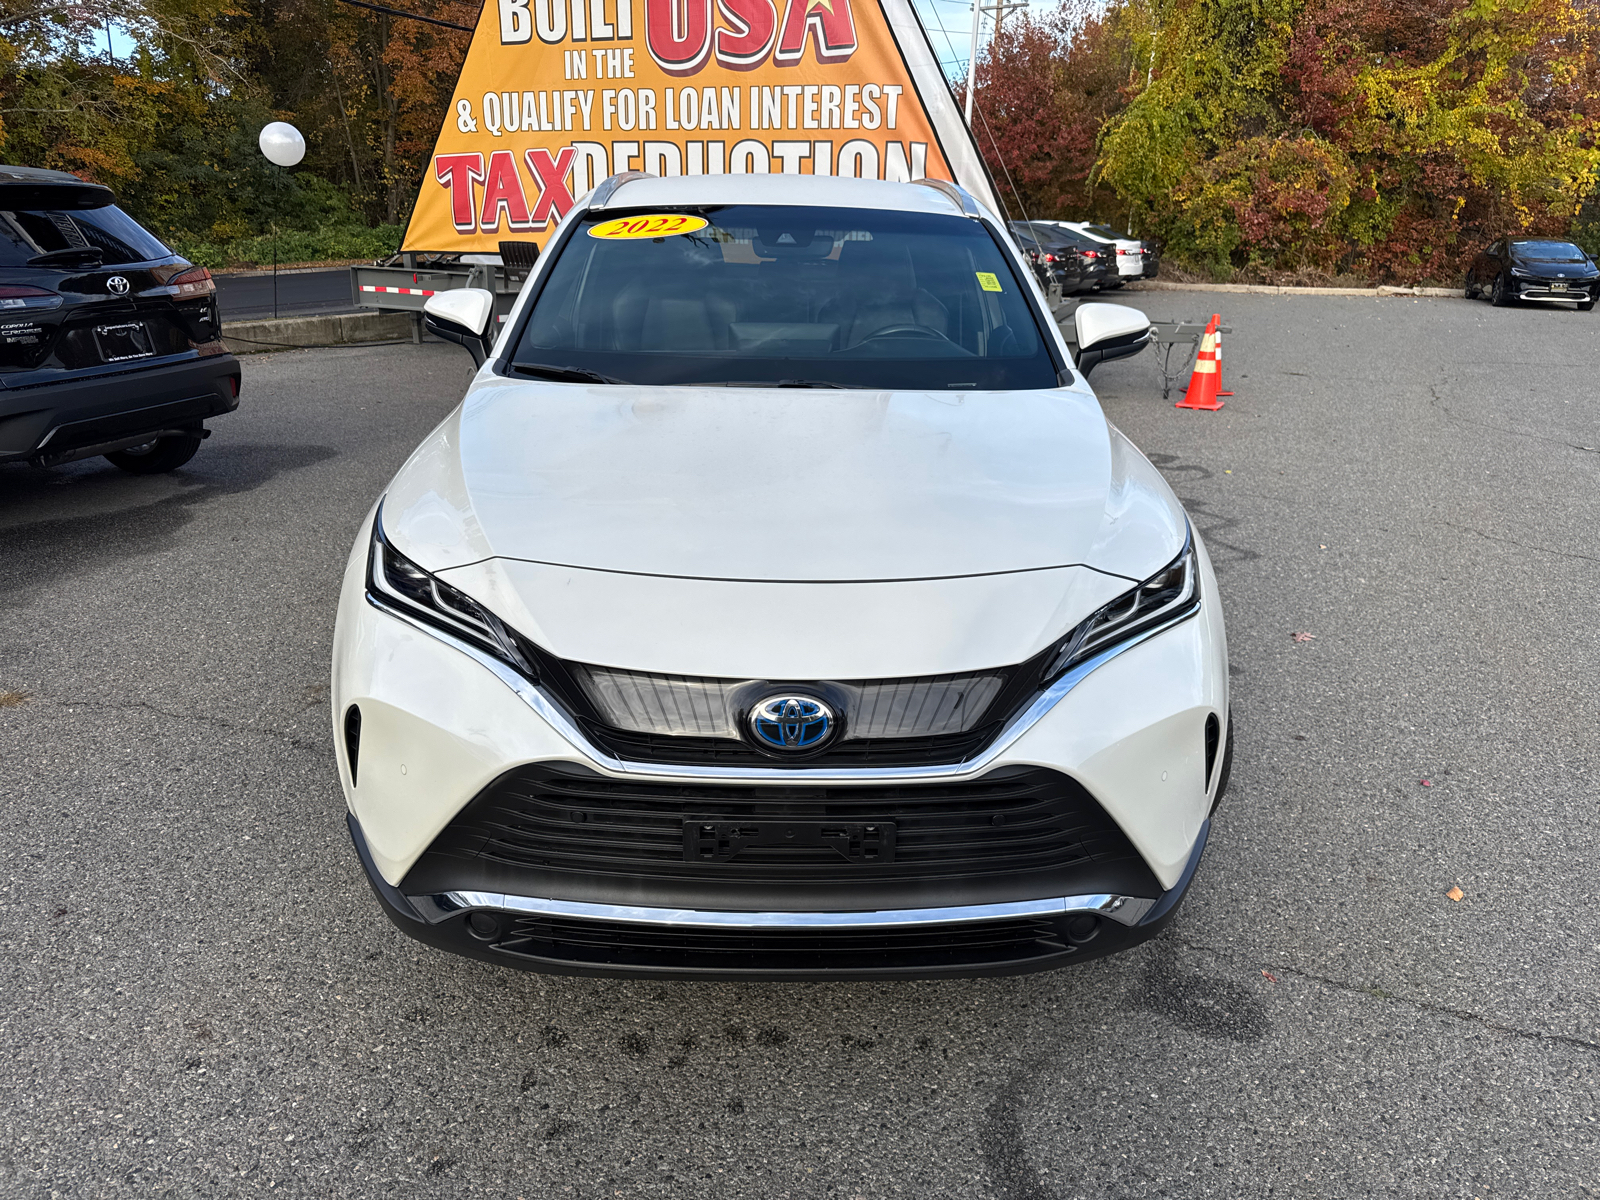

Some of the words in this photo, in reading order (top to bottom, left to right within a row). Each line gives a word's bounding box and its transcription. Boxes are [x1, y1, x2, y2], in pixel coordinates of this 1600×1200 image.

[564, 49, 588, 80] IN
[592, 47, 635, 79] THE
[456, 98, 478, 133] &
[482, 88, 595, 137] QUALIFY
[601, 87, 657, 131] FOR
[664, 85, 741, 131] LOAN
[749, 82, 903, 130] INTEREST
[435, 146, 578, 235] TAX
[605, 217, 688, 236] 2022
